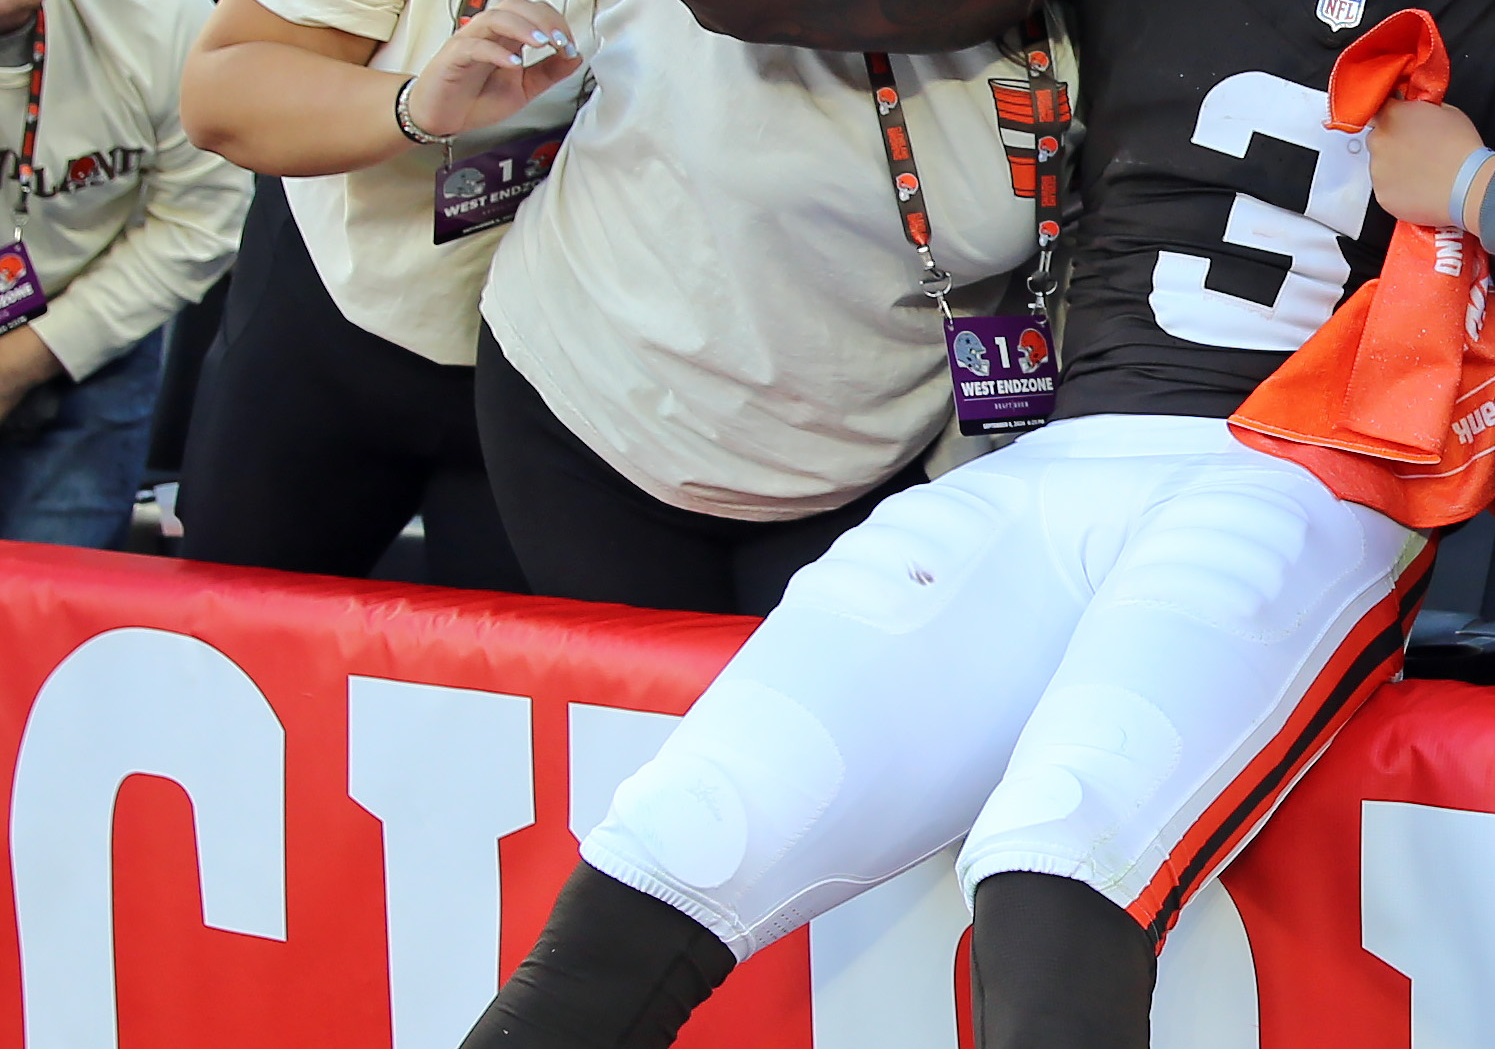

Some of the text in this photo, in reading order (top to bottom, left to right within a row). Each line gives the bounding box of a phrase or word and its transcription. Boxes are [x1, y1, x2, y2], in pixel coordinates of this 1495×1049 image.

[498, 159, 514, 183] 1
[443, 196, 488, 218] WEST
[1149, 71, 1373, 352] 3
[994, 337, 1011, 368] 1
[961, 377, 1054, 397] WEST ENDZONE
